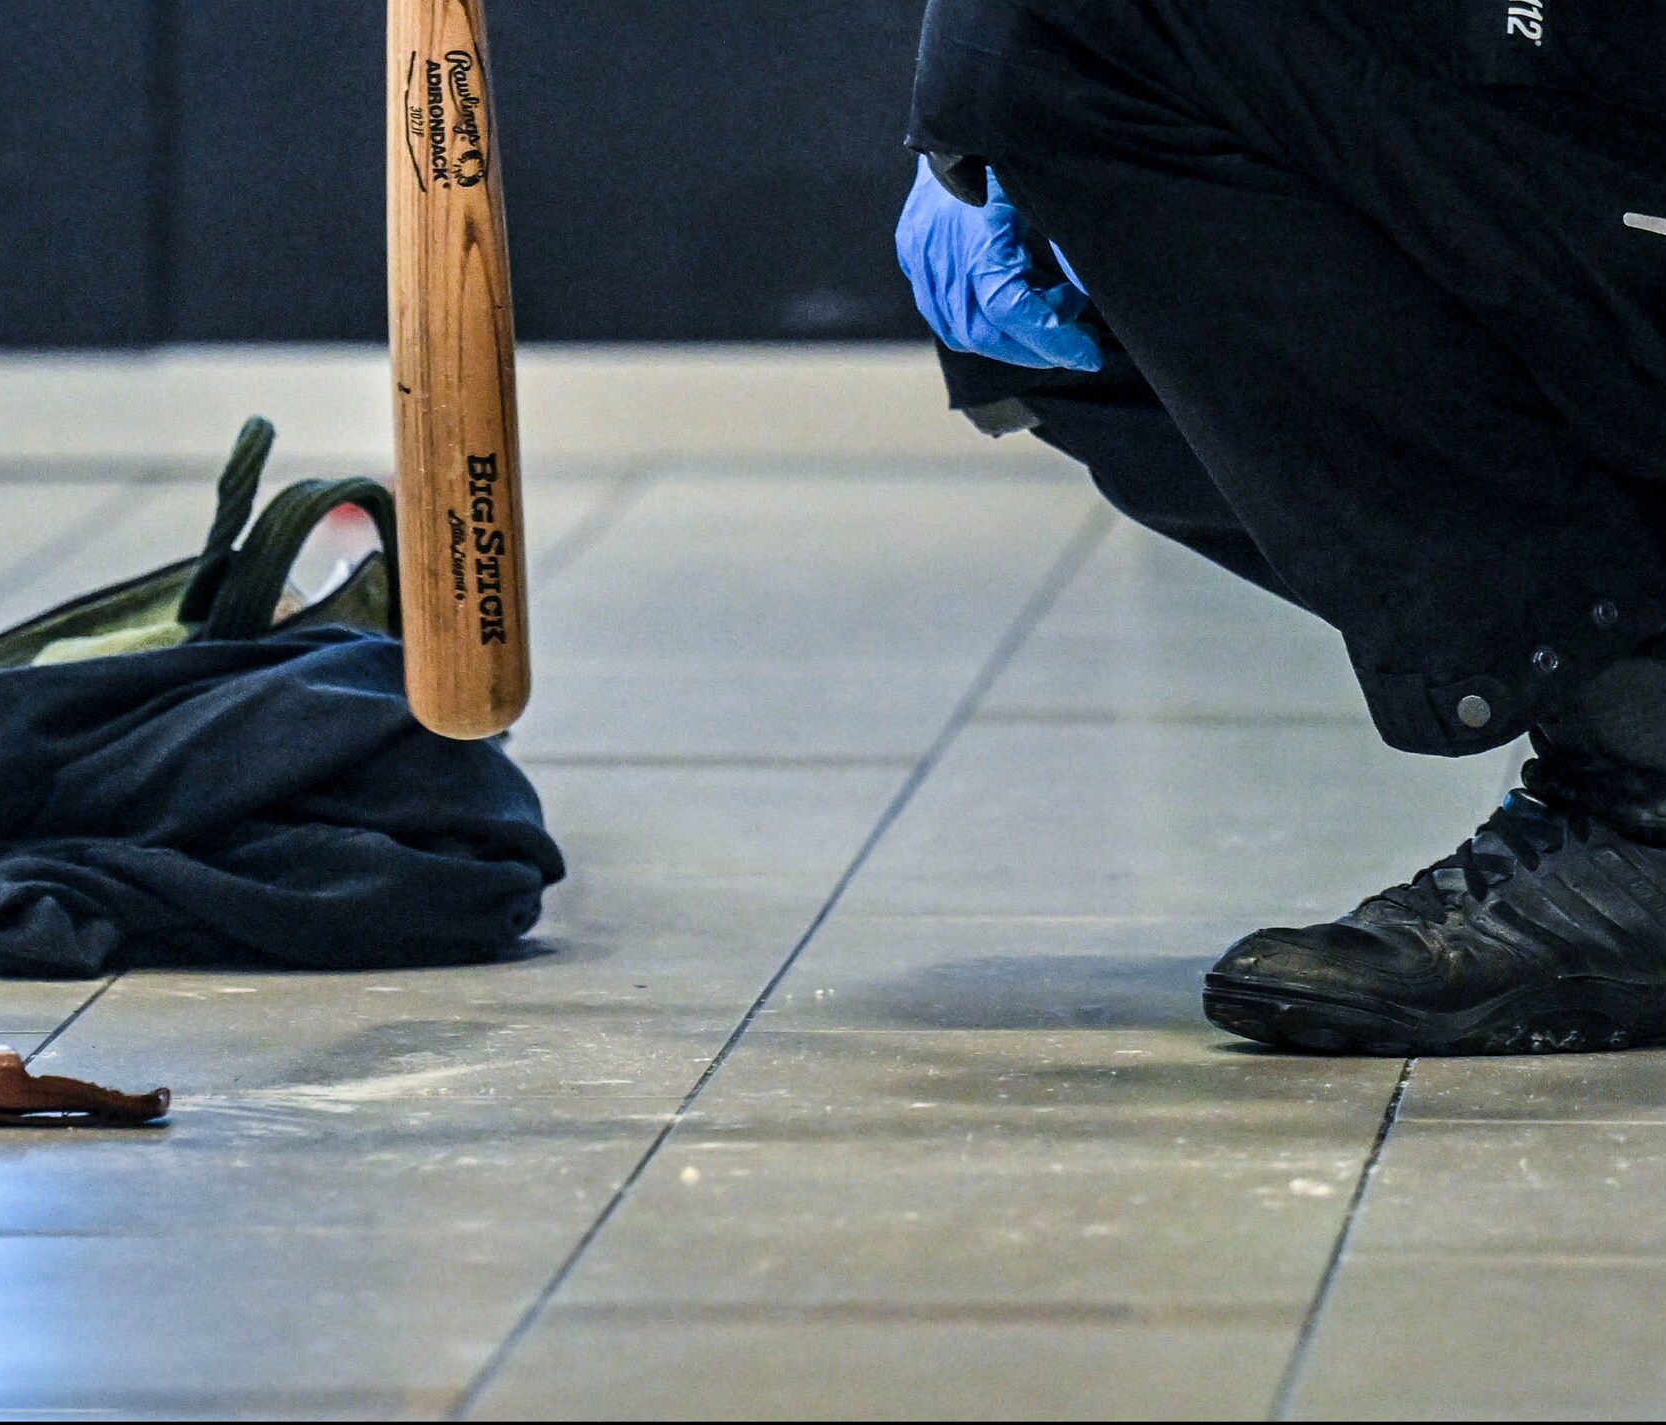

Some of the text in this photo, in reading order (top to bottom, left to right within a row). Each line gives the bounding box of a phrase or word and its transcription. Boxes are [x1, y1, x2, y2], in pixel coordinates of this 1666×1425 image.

[426, 60, 449, 181] ADIRONDACK
[445, 50, 481, 145] Rawlings
[467, 453, 506, 645] BIG STICK
